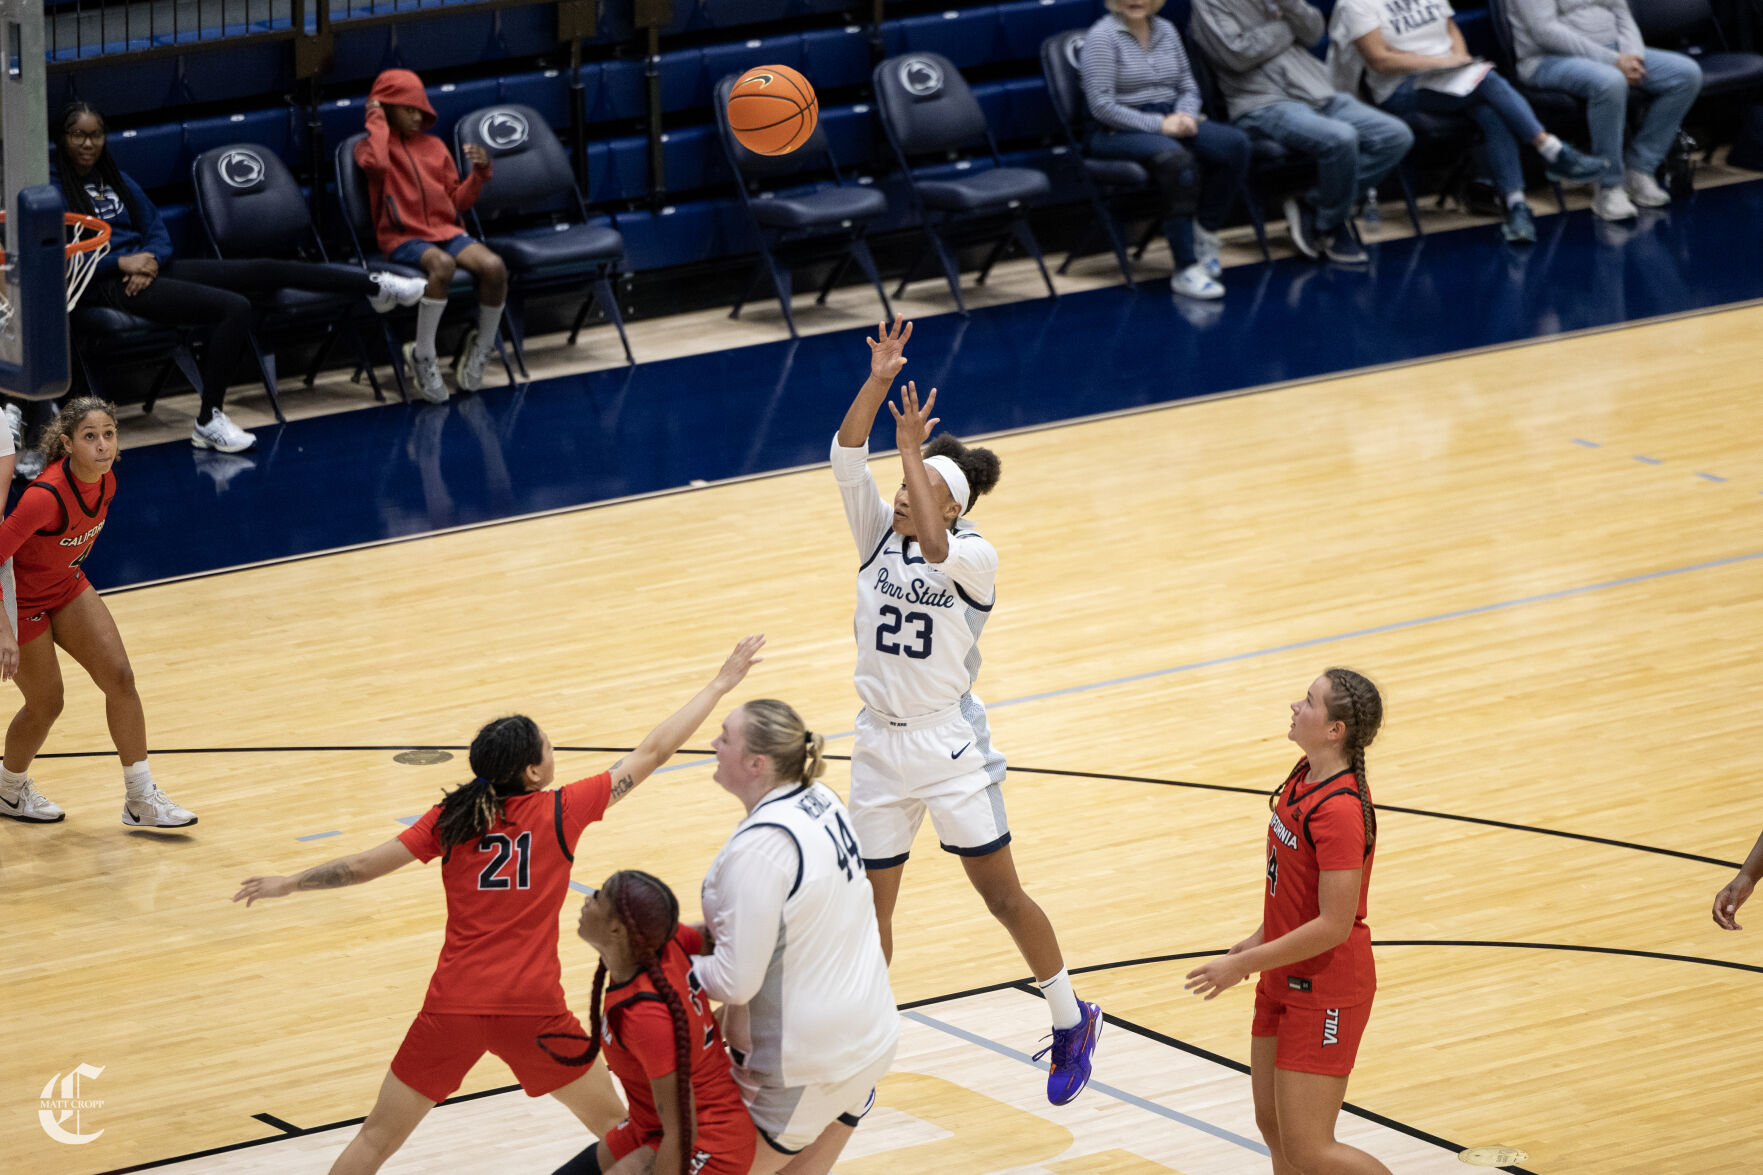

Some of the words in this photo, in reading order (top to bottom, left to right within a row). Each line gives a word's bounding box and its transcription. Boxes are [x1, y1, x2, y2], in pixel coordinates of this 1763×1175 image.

[874, 567, 904, 600] Penn
[905, 578, 954, 608] State
[876, 604, 933, 659] 23
[478, 831, 532, 890] 21
[825, 811, 862, 882] 44
